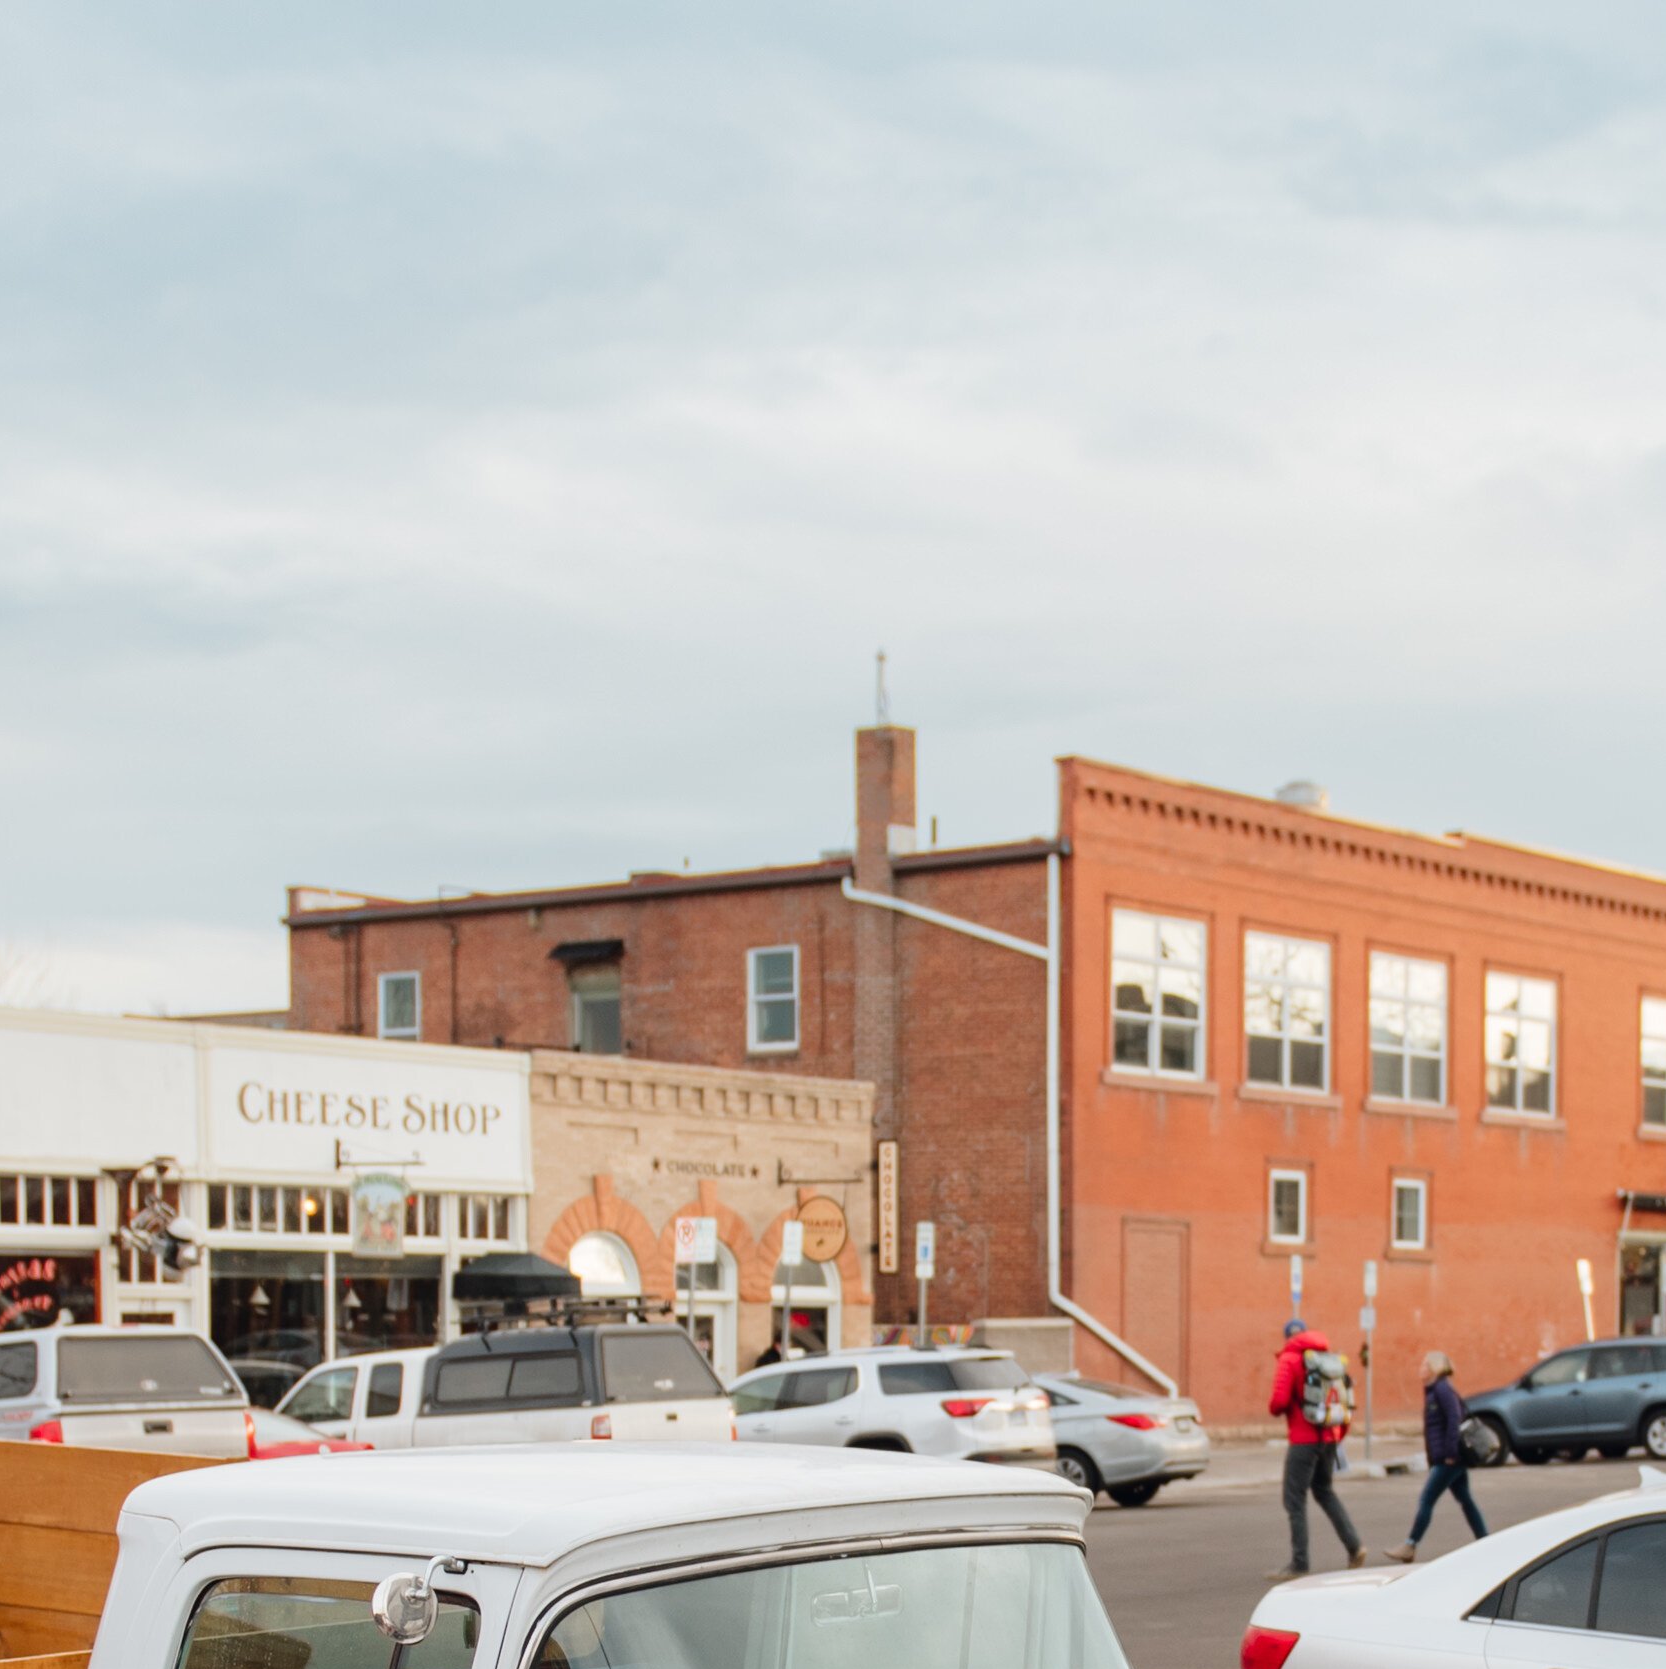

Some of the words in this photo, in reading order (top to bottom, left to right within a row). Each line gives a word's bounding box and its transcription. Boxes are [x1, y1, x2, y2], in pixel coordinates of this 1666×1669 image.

[236, 1080, 391, 1131] CHEESE
[401, 1093, 501, 1136] SHOP
[666, 1160, 746, 1178] CHOCOLATE
[883, 1147, 893, 1267] CHOCOLATE
